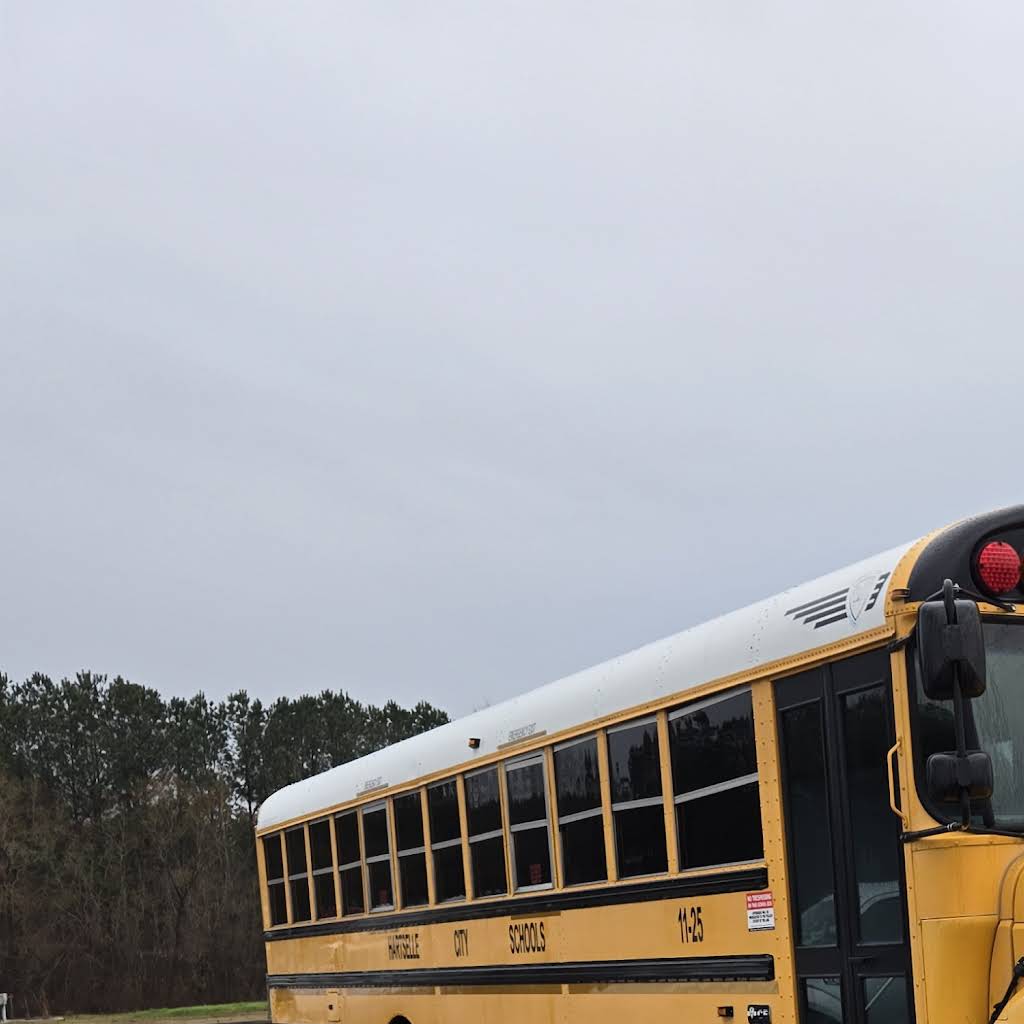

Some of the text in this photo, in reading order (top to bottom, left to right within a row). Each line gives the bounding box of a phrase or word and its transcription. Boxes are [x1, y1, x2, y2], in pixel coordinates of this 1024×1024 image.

[388, 922, 546, 960] HARTSELLE CITY SCHOOLS
[678, 907, 704, 944] 11-25
